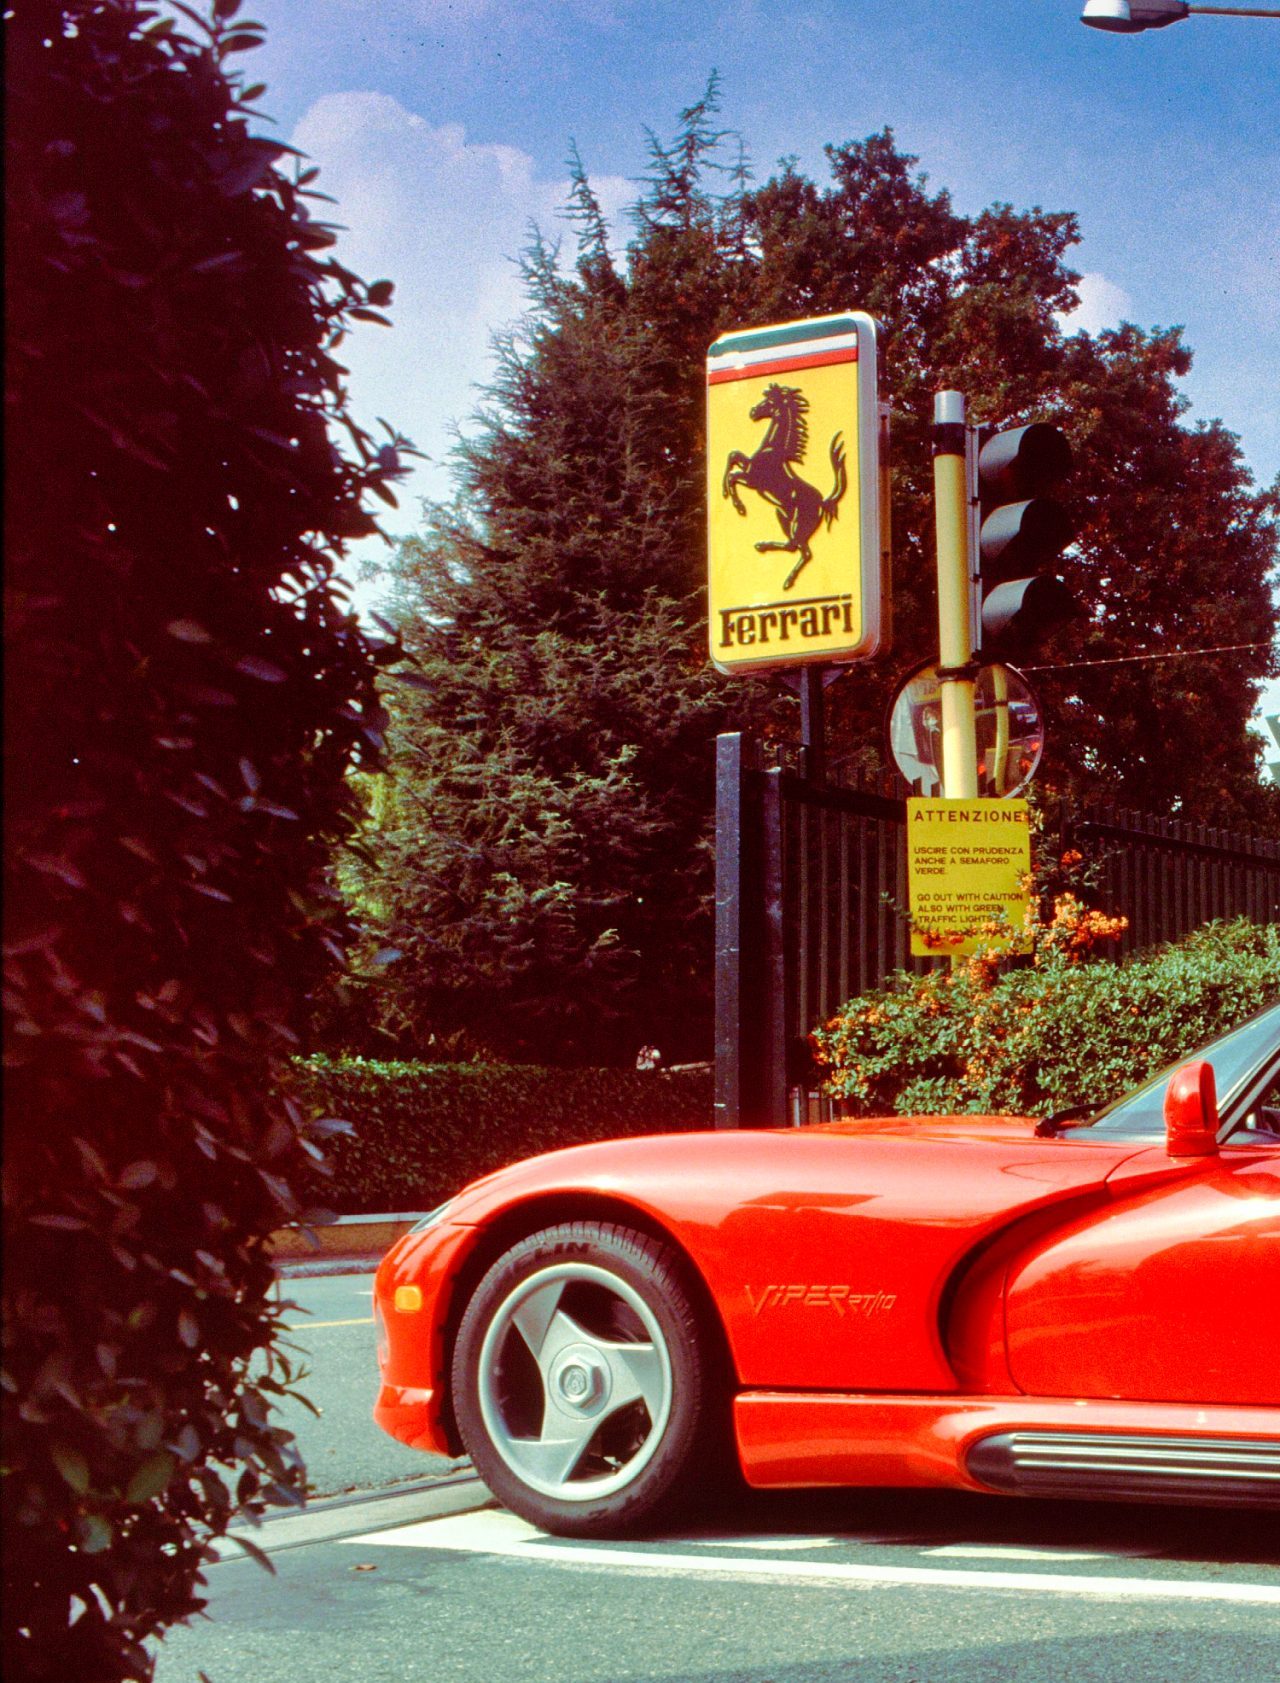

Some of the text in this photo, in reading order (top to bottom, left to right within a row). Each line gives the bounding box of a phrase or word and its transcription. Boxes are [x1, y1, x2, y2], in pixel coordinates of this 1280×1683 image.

[719, 594, 853, 648] Ferrari
[914, 810, 1022, 822] ATTENZIONE
[914, 847, 1024, 855] USCIRE CON PRUDENZA
[914, 857, 1010, 865] ANCHE A SEMAFORO
[917, 893, 1023, 901] GO OUT WITH CAUTION
[918, 904, 1004, 913] ALSO WITH GREEN
[918, 915, 957, 923] TRAFFIC
